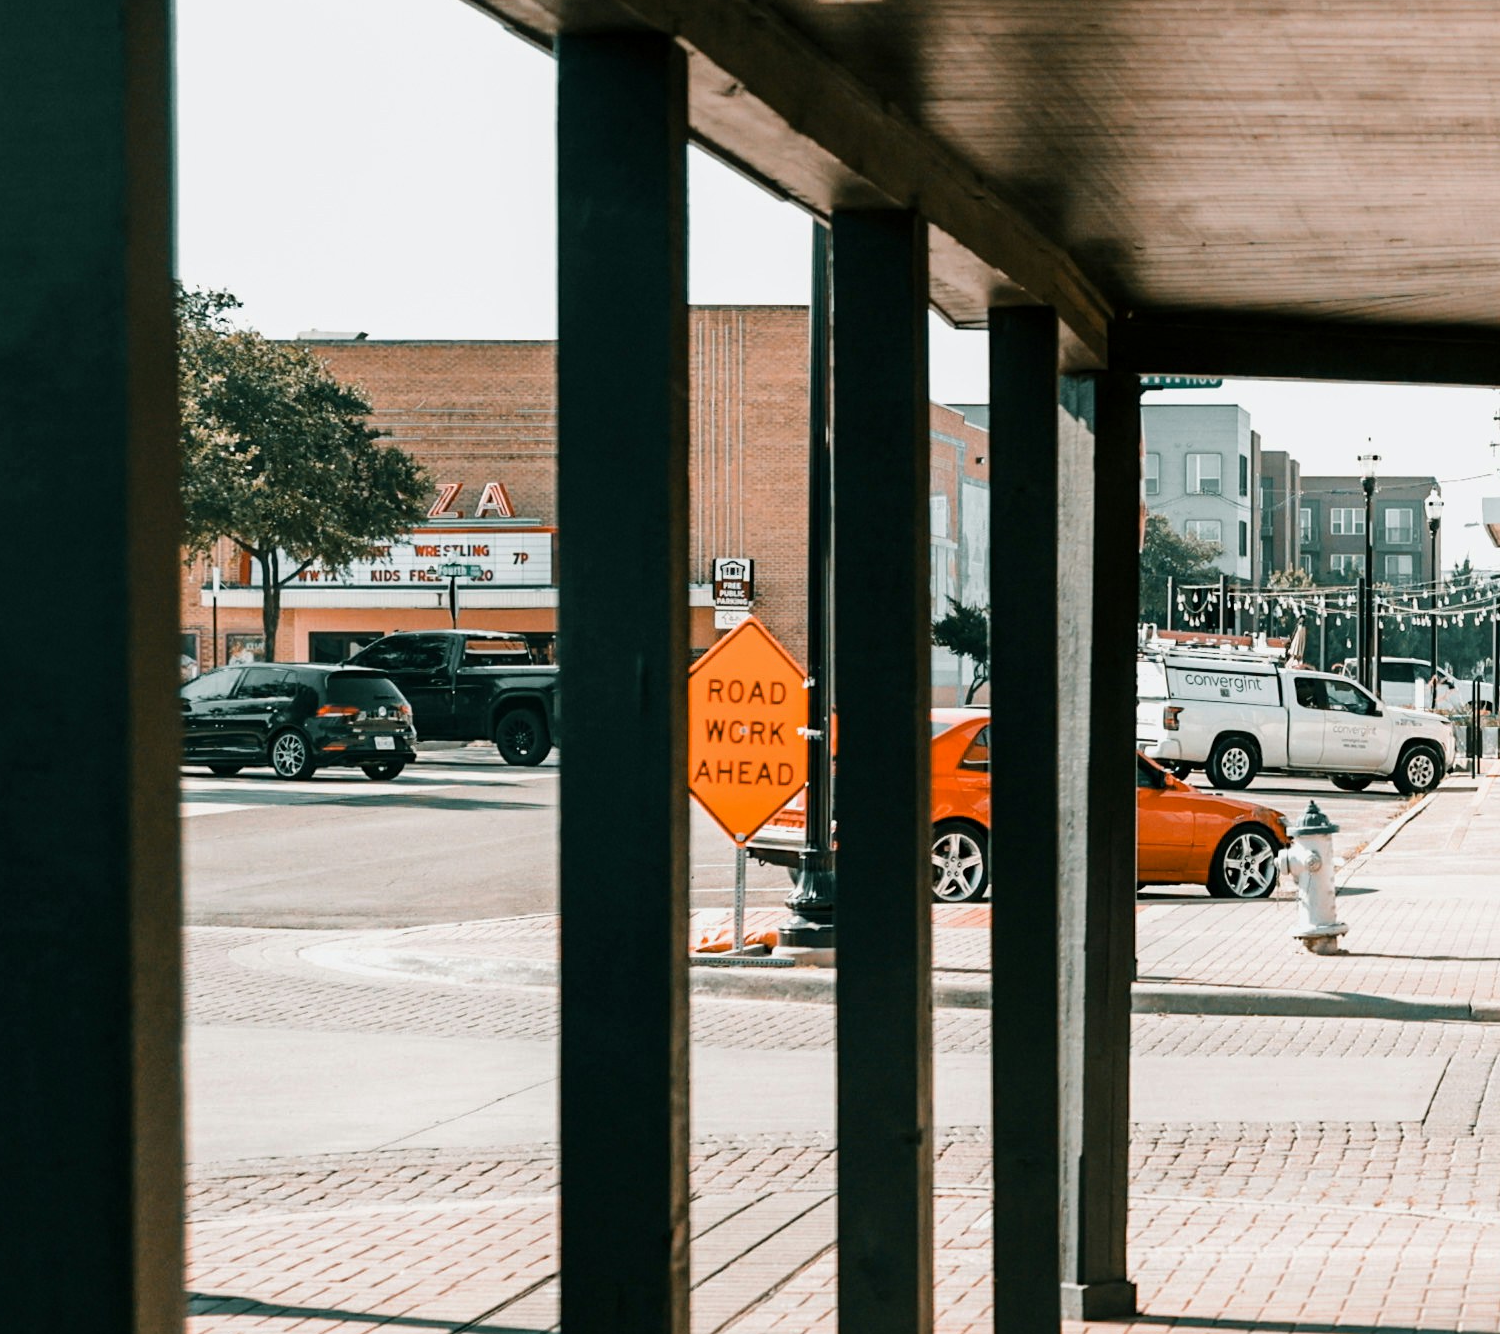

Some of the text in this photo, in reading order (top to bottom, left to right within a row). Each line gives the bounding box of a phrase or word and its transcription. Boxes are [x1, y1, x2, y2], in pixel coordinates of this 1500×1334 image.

[370, 569, 401, 582] KIDS
[722, 581, 743, 590] FREE
[718, 589, 746, 598] PUBLIC
[715, 597, 749, 606] PARKING
[1185, 674, 1263, 693] convergint
[707, 679, 787, 705] ROAD
[705, 719, 786, 746] WORK
[1332, 724, 1378, 737] convergint
[693, 759, 795, 787] AHEAD
